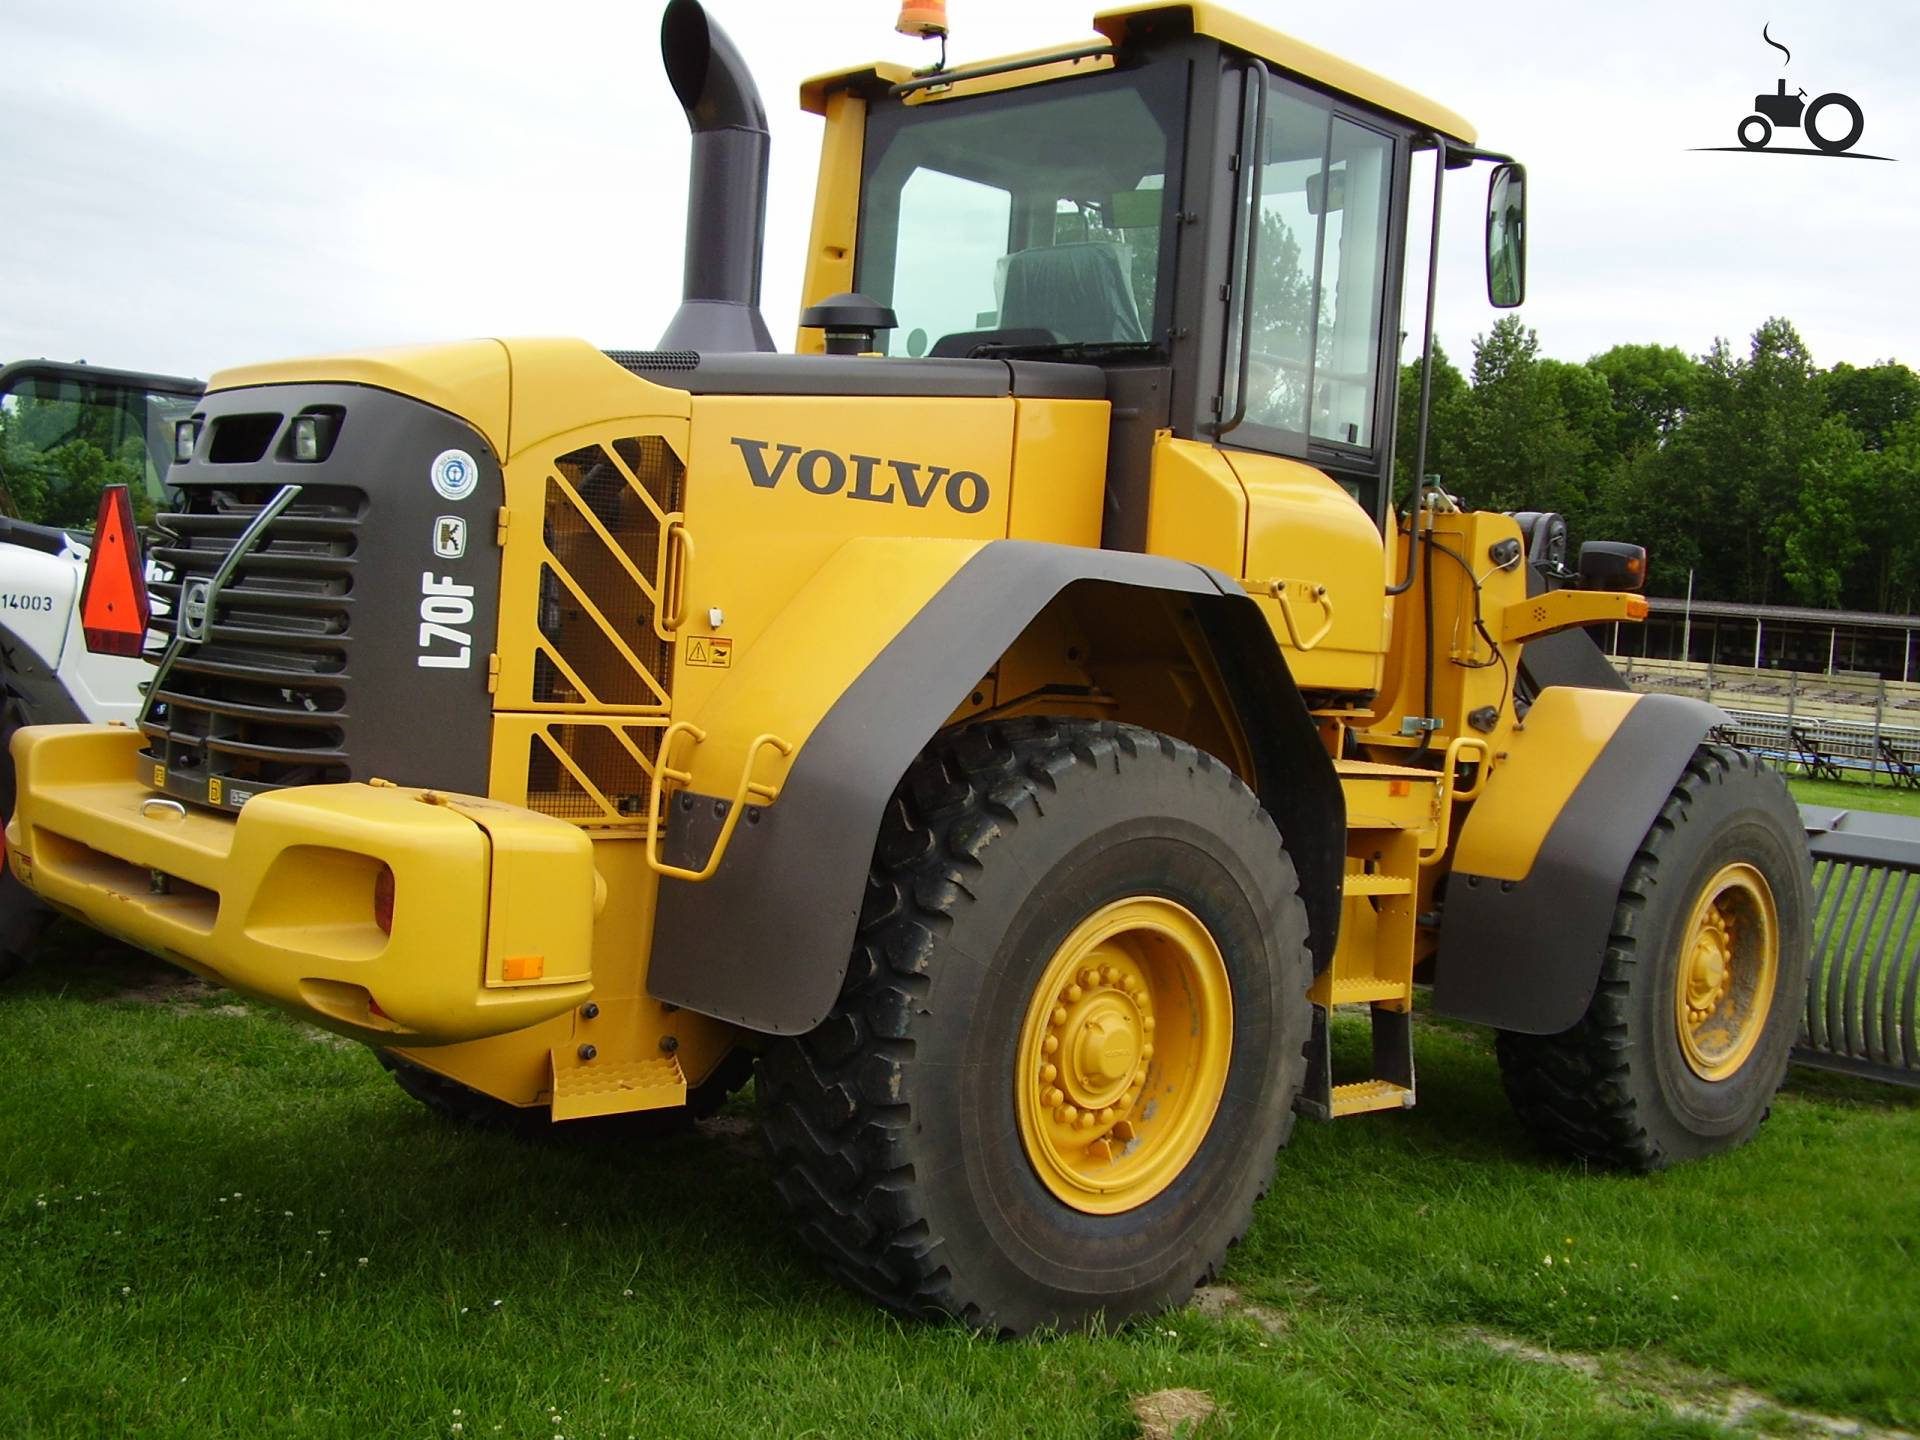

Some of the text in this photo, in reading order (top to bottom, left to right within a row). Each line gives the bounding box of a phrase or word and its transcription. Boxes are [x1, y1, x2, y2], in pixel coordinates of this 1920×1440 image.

[731, 437, 990, 514] VOLVO
[2, 594, 53, 611] 14003
[418, 571, 475, 669] L70F
